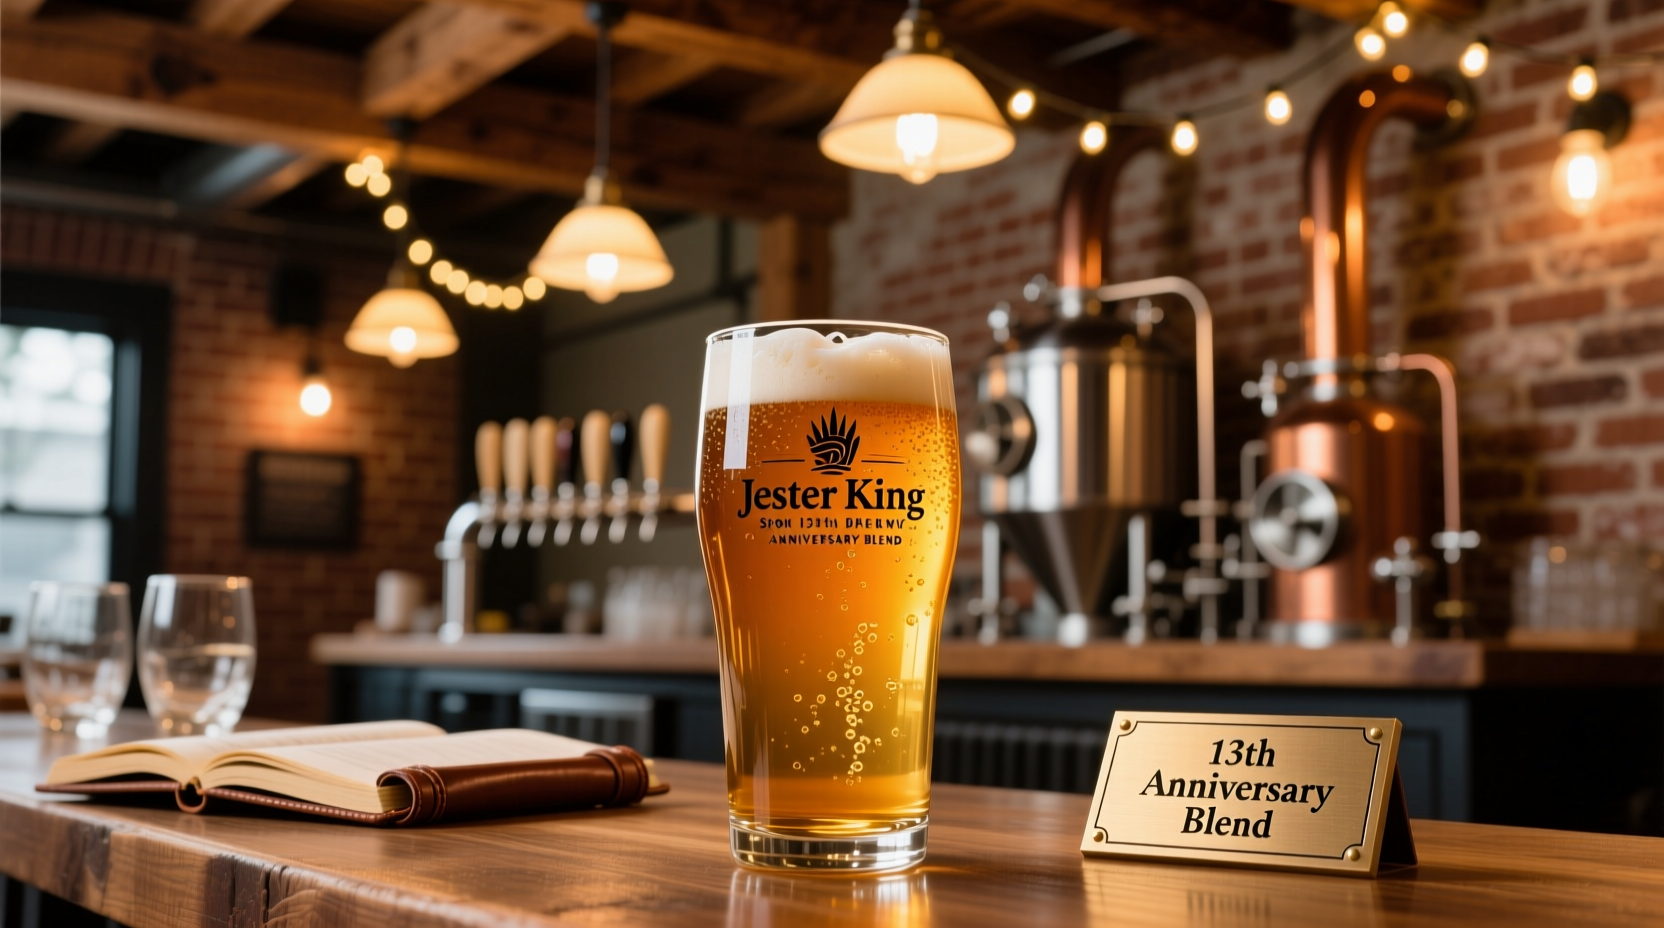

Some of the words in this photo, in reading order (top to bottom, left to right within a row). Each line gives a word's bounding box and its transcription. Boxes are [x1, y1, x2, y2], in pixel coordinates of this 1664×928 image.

[737, 478, 837, 518] Jester
[845, 478, 925, 520] King
[864, 534, 902, 545] BLEND
[1209, 738, 1275, 767] 13th
[1139, 769, 1335, 813] Anniversary
[1180, 806, 1273, 838] Blend
